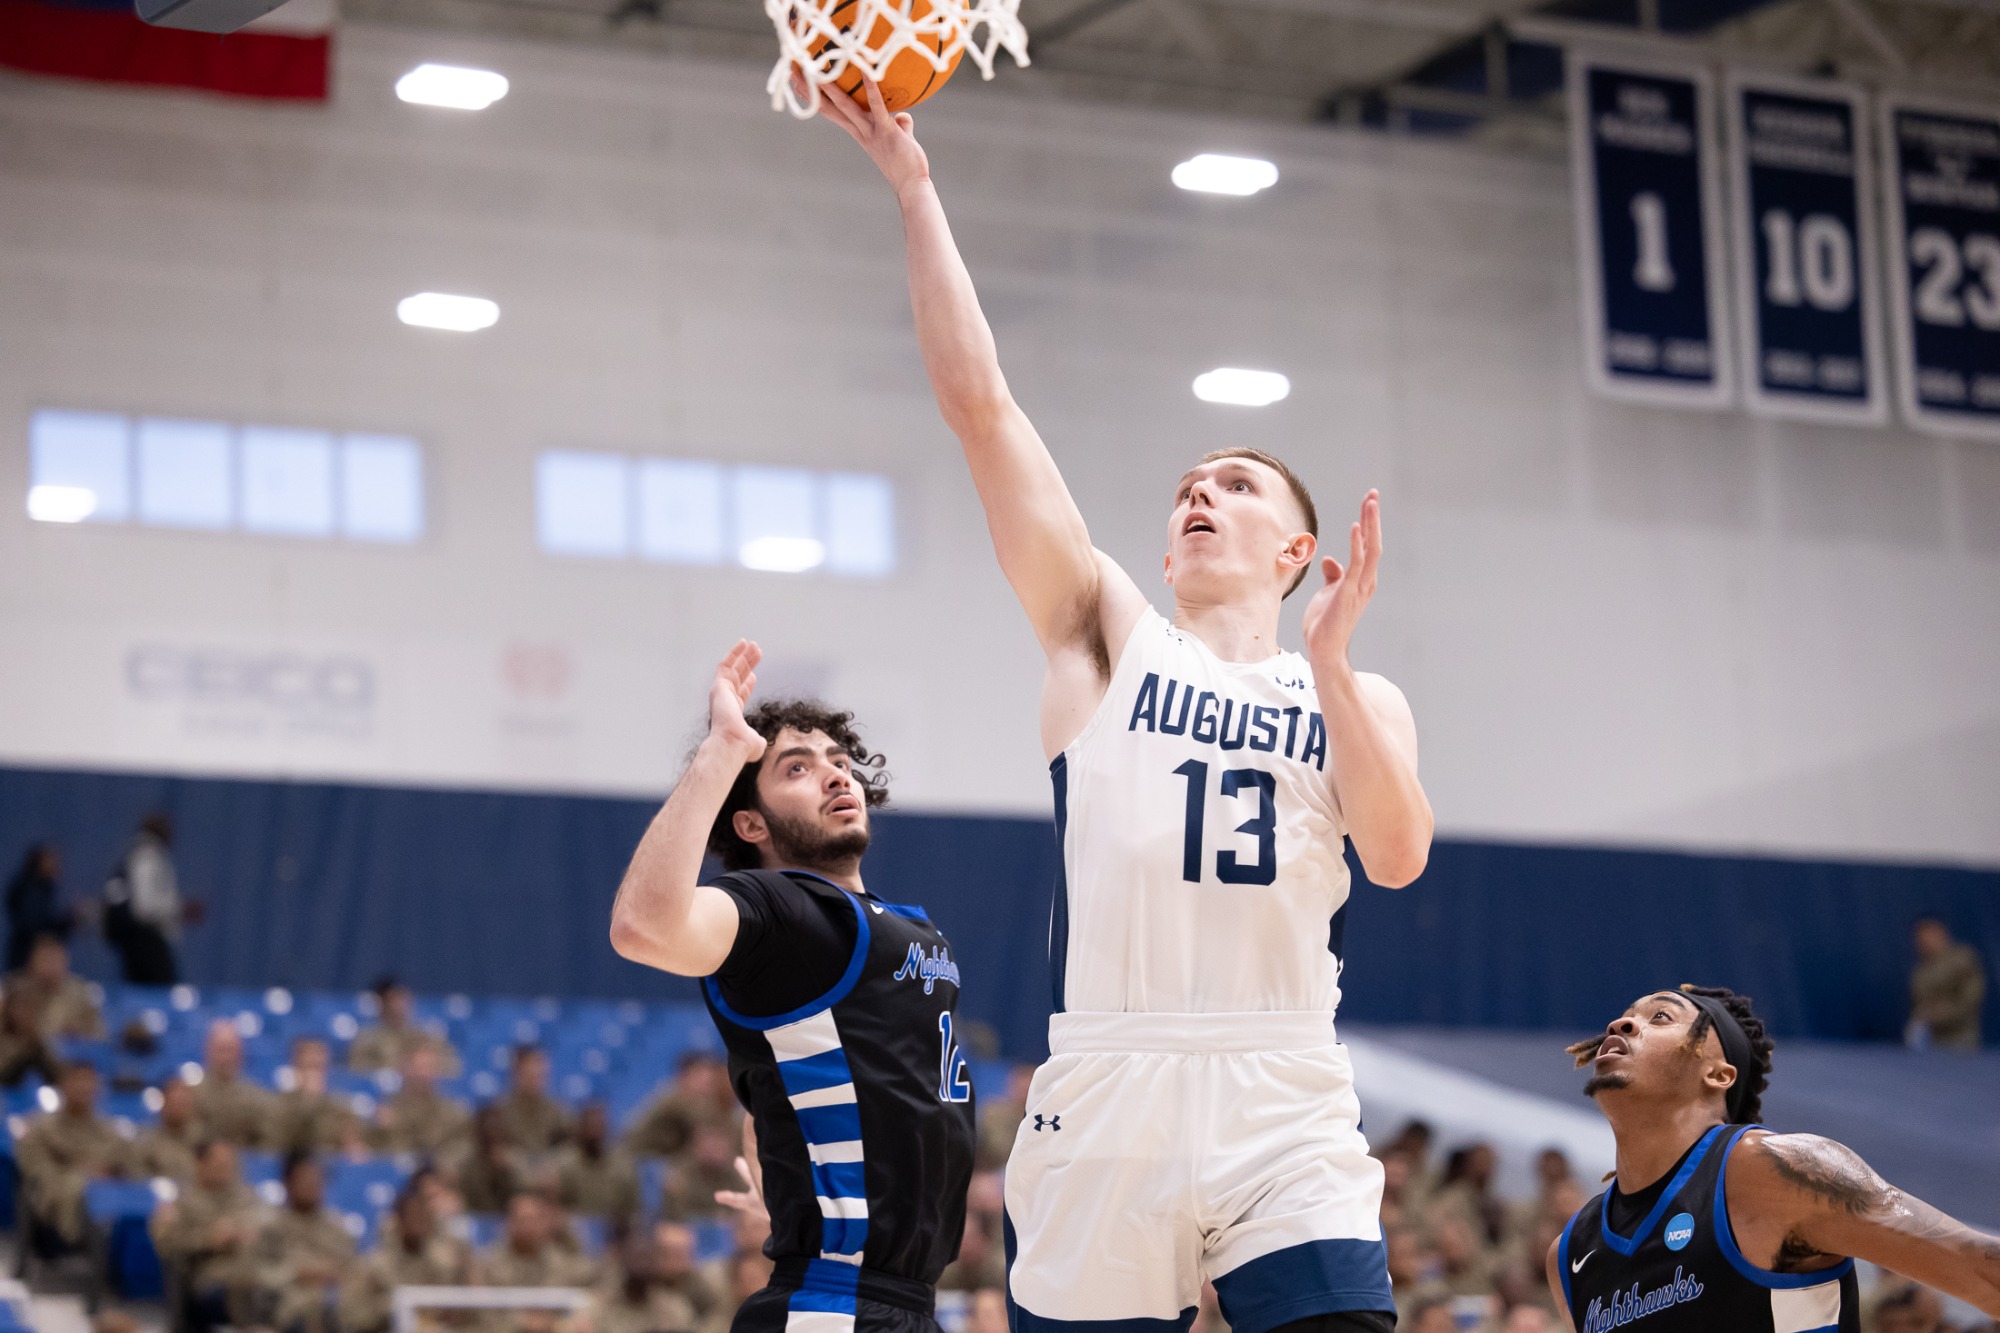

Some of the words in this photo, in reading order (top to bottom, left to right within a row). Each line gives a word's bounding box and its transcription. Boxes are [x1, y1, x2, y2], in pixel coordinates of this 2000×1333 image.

[1630, 192, 1676, 293] 1
[1761, 208, 1854, 311] 10
[1910, 227, 2000, 331] 23
[1128, 672, 1327, 772] AUGUSTA
[1171, 758, 1277, 886] 13
[1667, 1228, 1692, 1242] NCAA
[1583, 1265, 1704, 1333] Nighthawks
